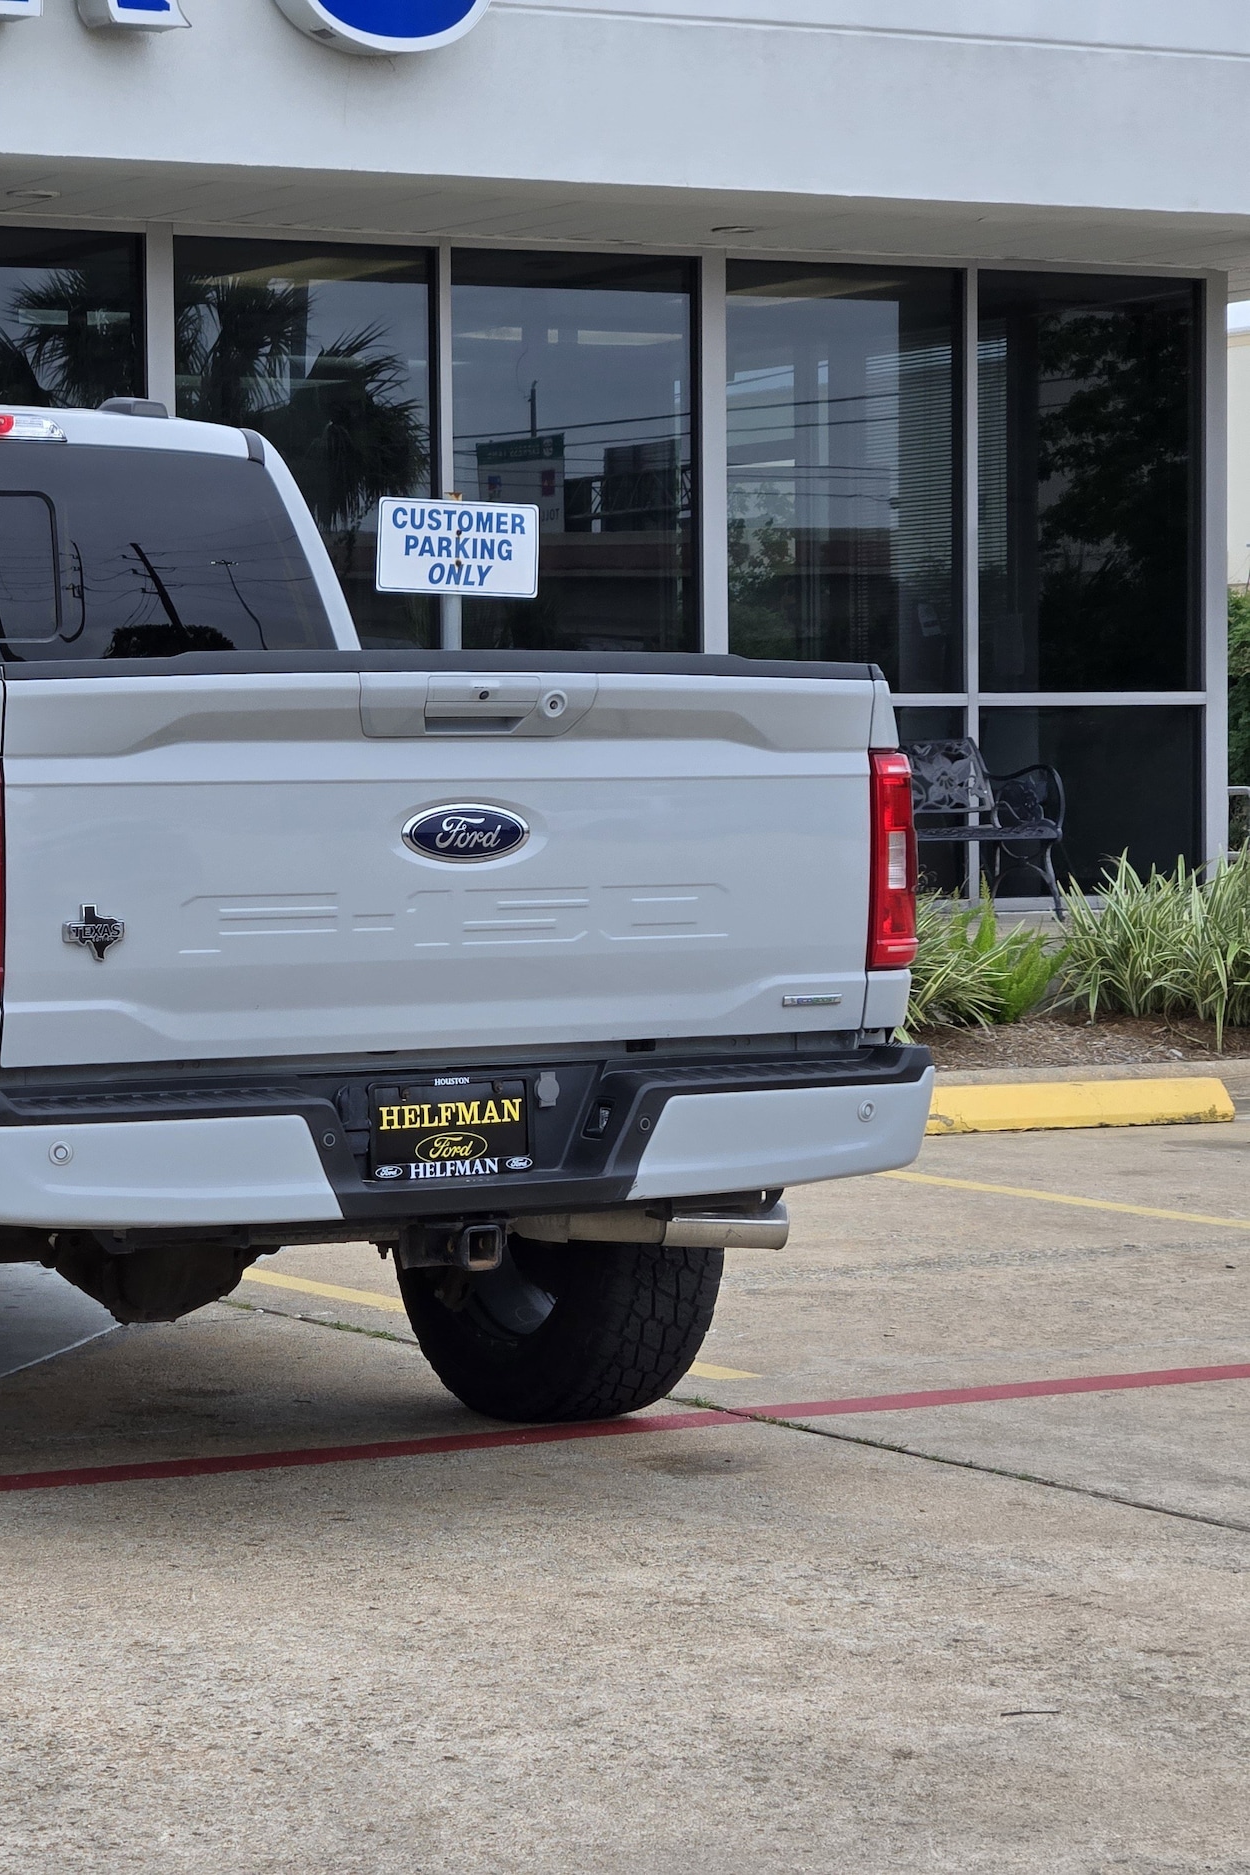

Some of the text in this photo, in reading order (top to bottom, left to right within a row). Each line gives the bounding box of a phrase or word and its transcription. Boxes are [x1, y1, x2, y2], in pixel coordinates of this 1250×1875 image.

[392, 507, 526, 535] CUSTOMER
[404, 535, 513, 561] PARKING
[428, 563, 493, 586] ONLY
[435, 816, 502, 849] Ford
[70, 923, 121, 938] TEXAS
[434, 1077, 470, 1086] HOUSTON
[379, 1098, 523, 1131] HELFMAN
[429, 1136, 474, 1160] Ford
[409, 1157, 500, 1180] HELFMAN
